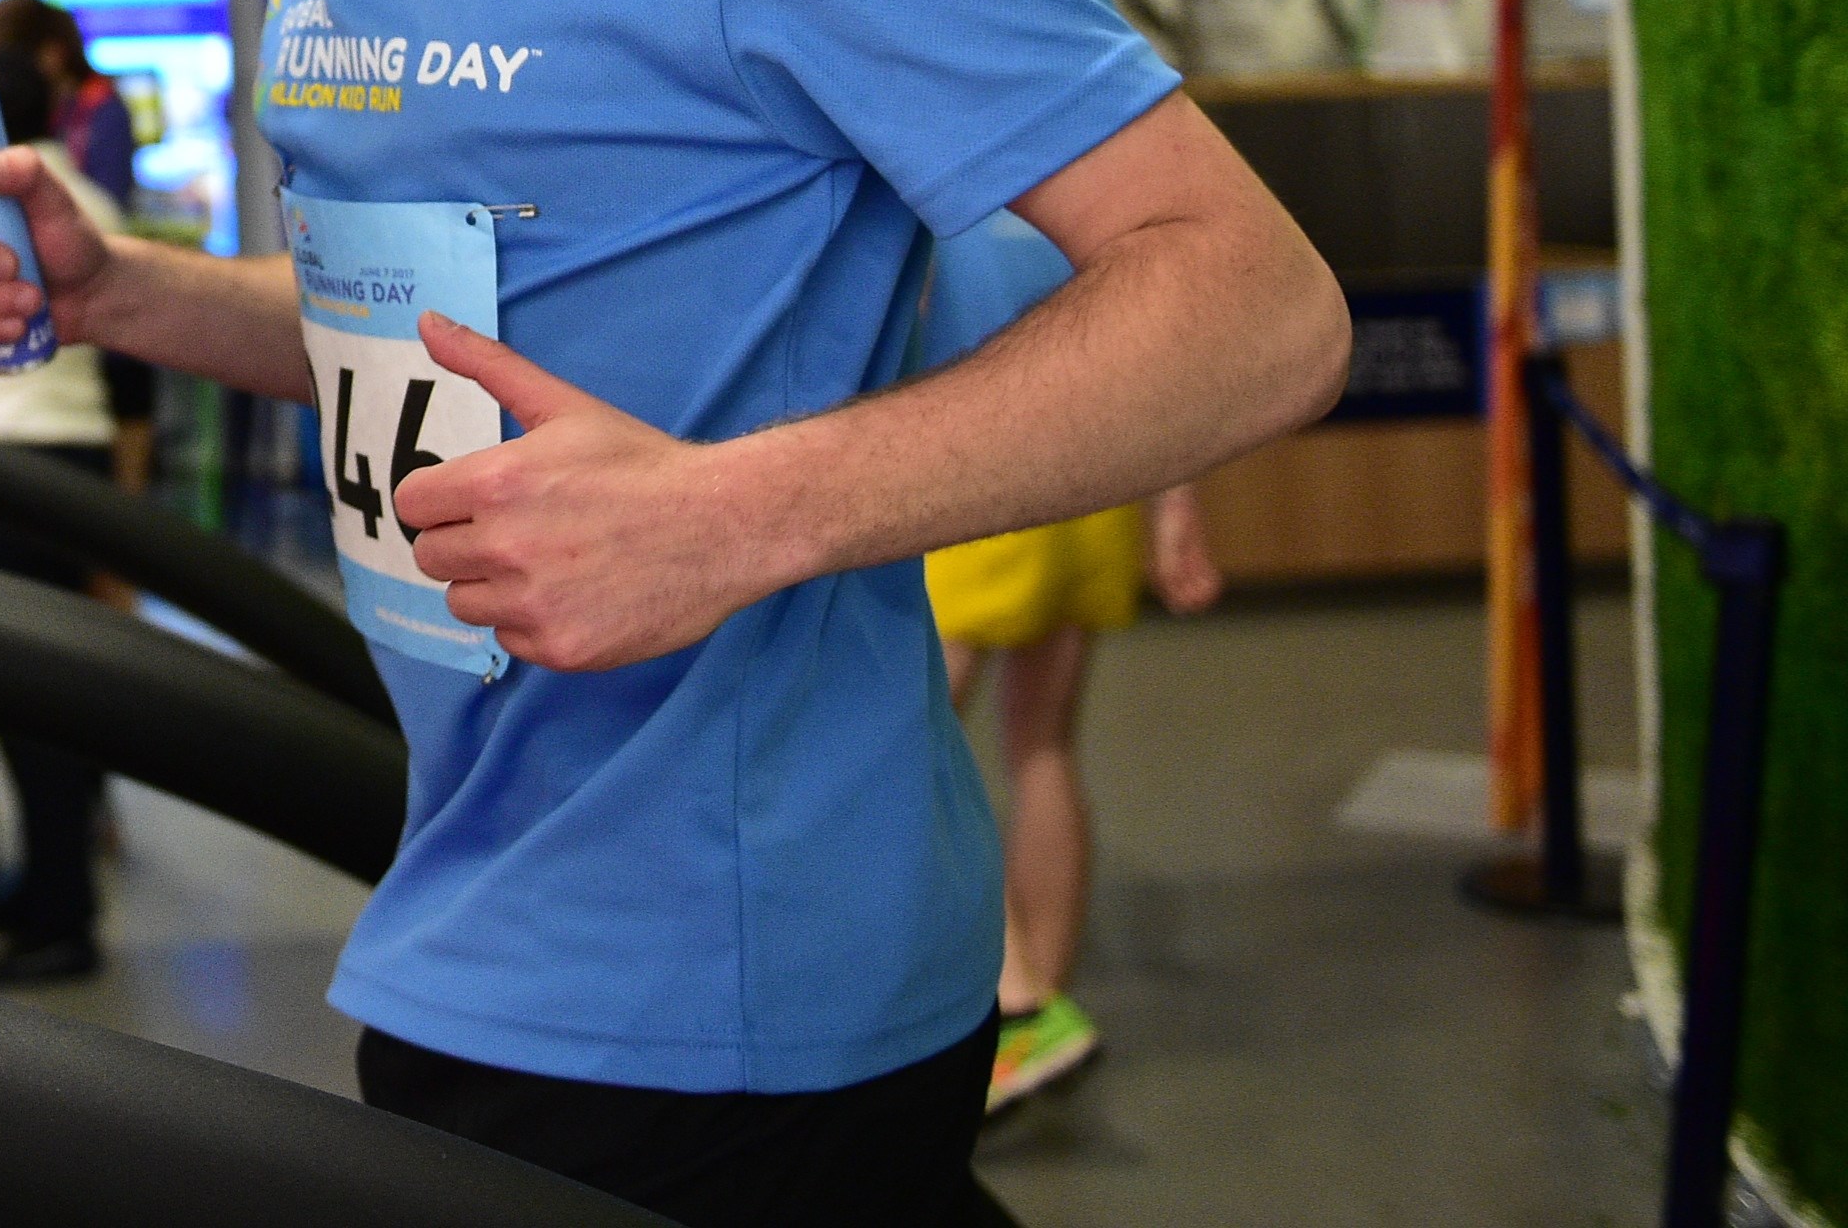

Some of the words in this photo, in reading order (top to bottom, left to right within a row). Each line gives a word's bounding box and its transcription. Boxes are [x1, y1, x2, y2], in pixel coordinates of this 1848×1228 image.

[369, 85, 402, 113] RUN
[371, 281, 416, 306] DAY
[315, 367, 450, 547] 46
